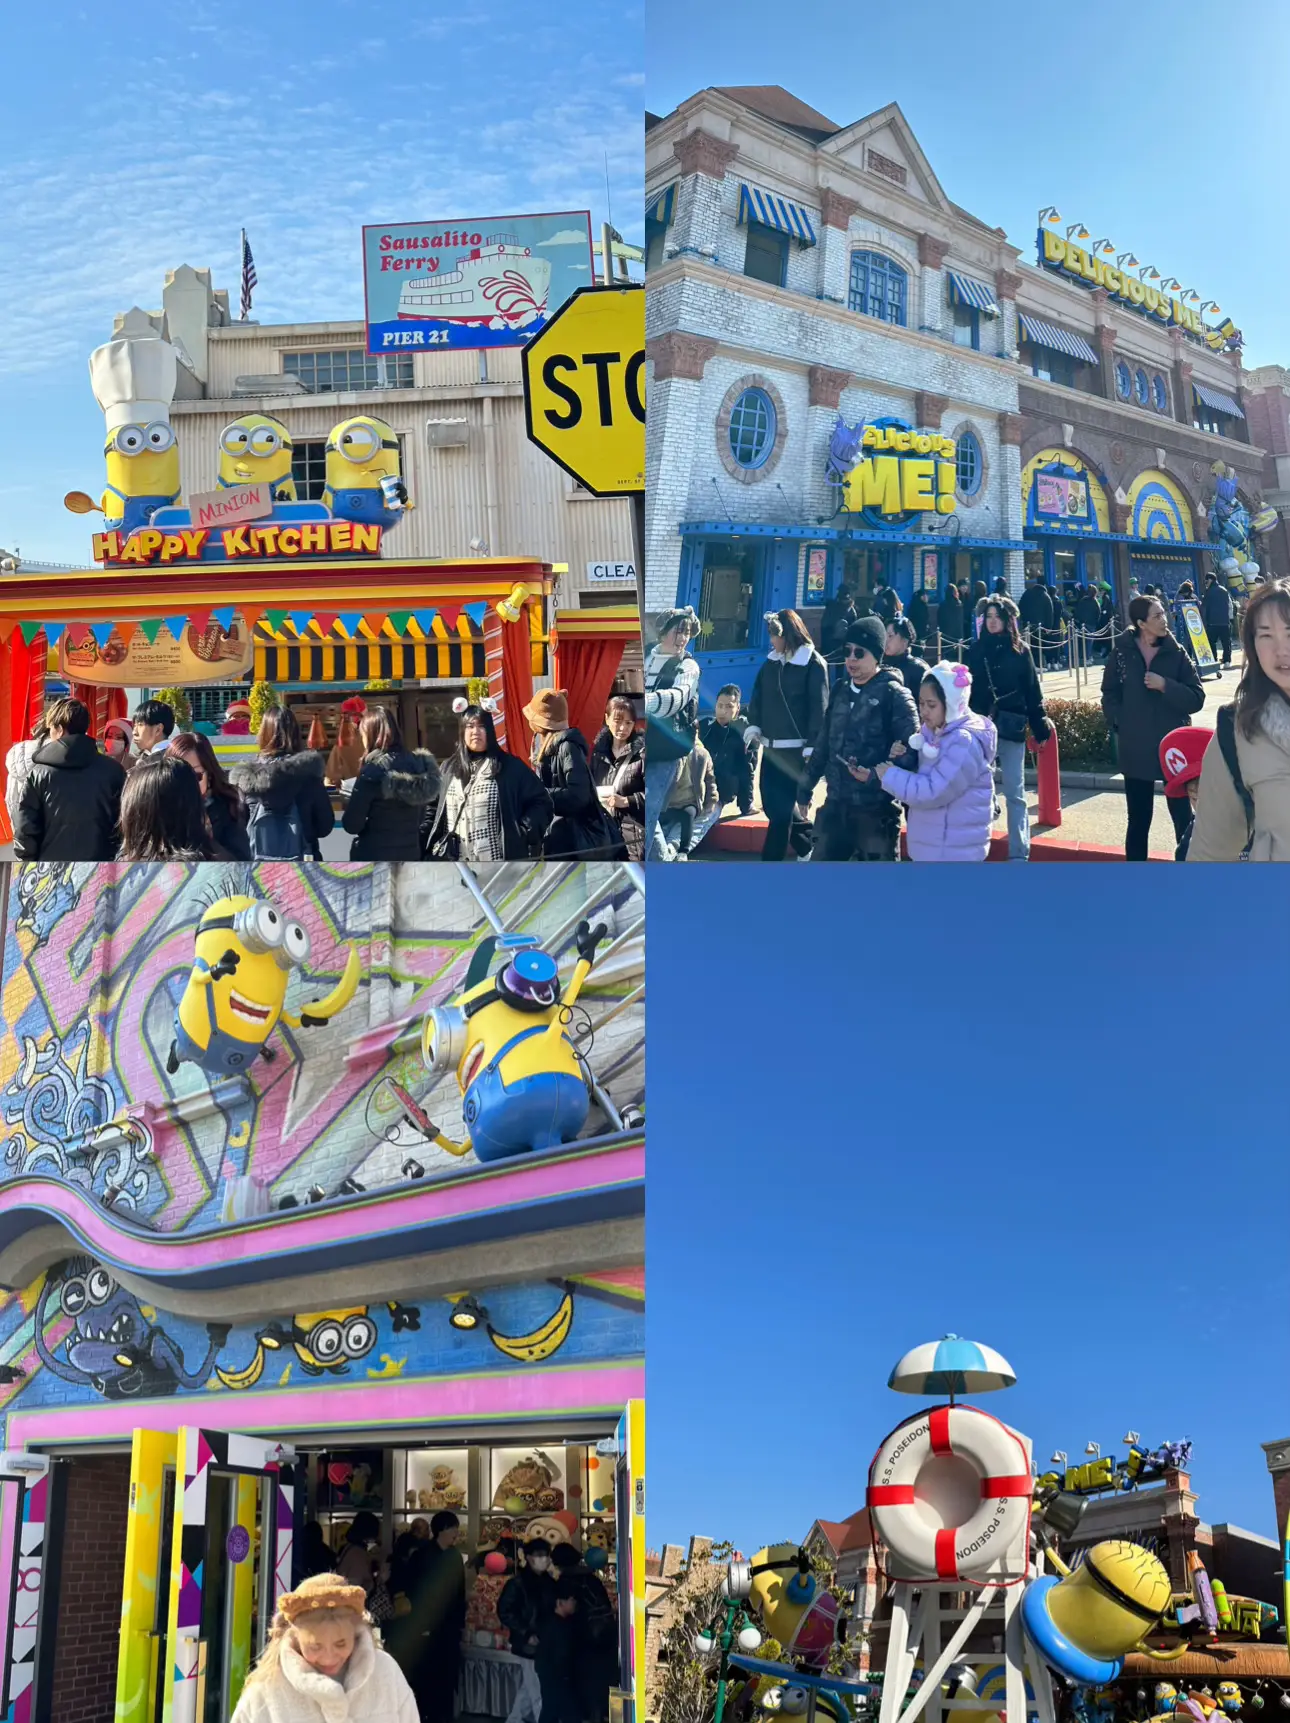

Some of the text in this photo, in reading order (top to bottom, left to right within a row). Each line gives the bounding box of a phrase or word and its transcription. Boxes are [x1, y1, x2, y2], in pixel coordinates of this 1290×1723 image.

[379, 231, 482, 251] Sausalito
[380, 255, 440, 273] Ferry
[1043, 229, 1172, 320] DELICIOUS
[382, 329, 450, 346] PIER 21
[863, 425, 956, 458] ELICIOUS
[840, 456, 956, 515] ME!
[199, 487, 261, 525] MINION
[92, 523, 382, 564] HAPPY KITCHEN
[593, 564, 636, 578] CLEA
[881, 1423, 931, 1485] S.S. POSEIDON
[955, 1496, 1008, 1560] S.S. POSEIDON
